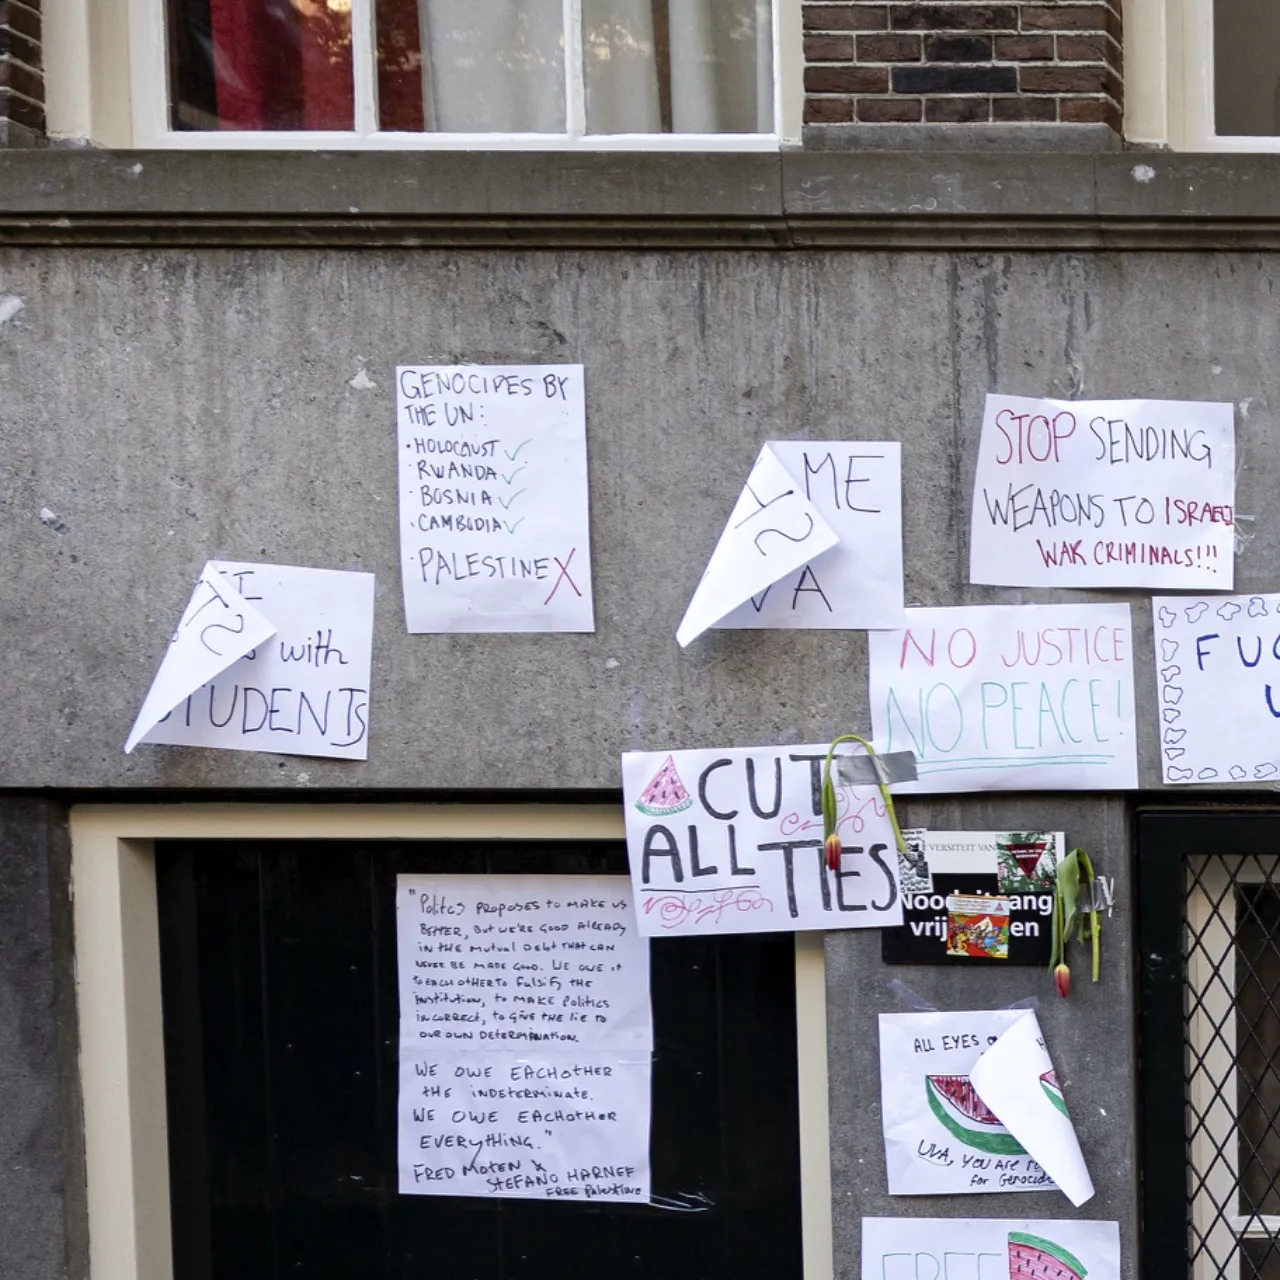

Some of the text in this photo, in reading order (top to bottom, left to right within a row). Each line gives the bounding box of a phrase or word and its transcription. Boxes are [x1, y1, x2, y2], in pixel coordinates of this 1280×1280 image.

[544, 376, 569, 400] BY
[404, 405, 436, 425] THE
[415, 438, 500, 458] HOLOCAUST
[995, 410, 1212, 468] STOP SENDING
[417, 461, 497, 480] RWANDA
[421, 487, 492, 506] BOSNIA
[984, 483, 1155, 532] WEAPONS TO
[418, 515, 501, 532] CAMBODIA
[420, 548, 550, 584] PALESTINE
[280, 630, 349, 667] with
[900, 626, 1125, 669] NO JUSTICE
[886, 679, 1123, 760] NO PEACE!
[699, 754, 843, 821] CUT
[642, 823, 899, 919] ALL TIES
[914, 1034, 979, 1053] ALL EYES
[455, 1067, 493, 1078] OWE
[452, 1110, 498, 1123] OWE
